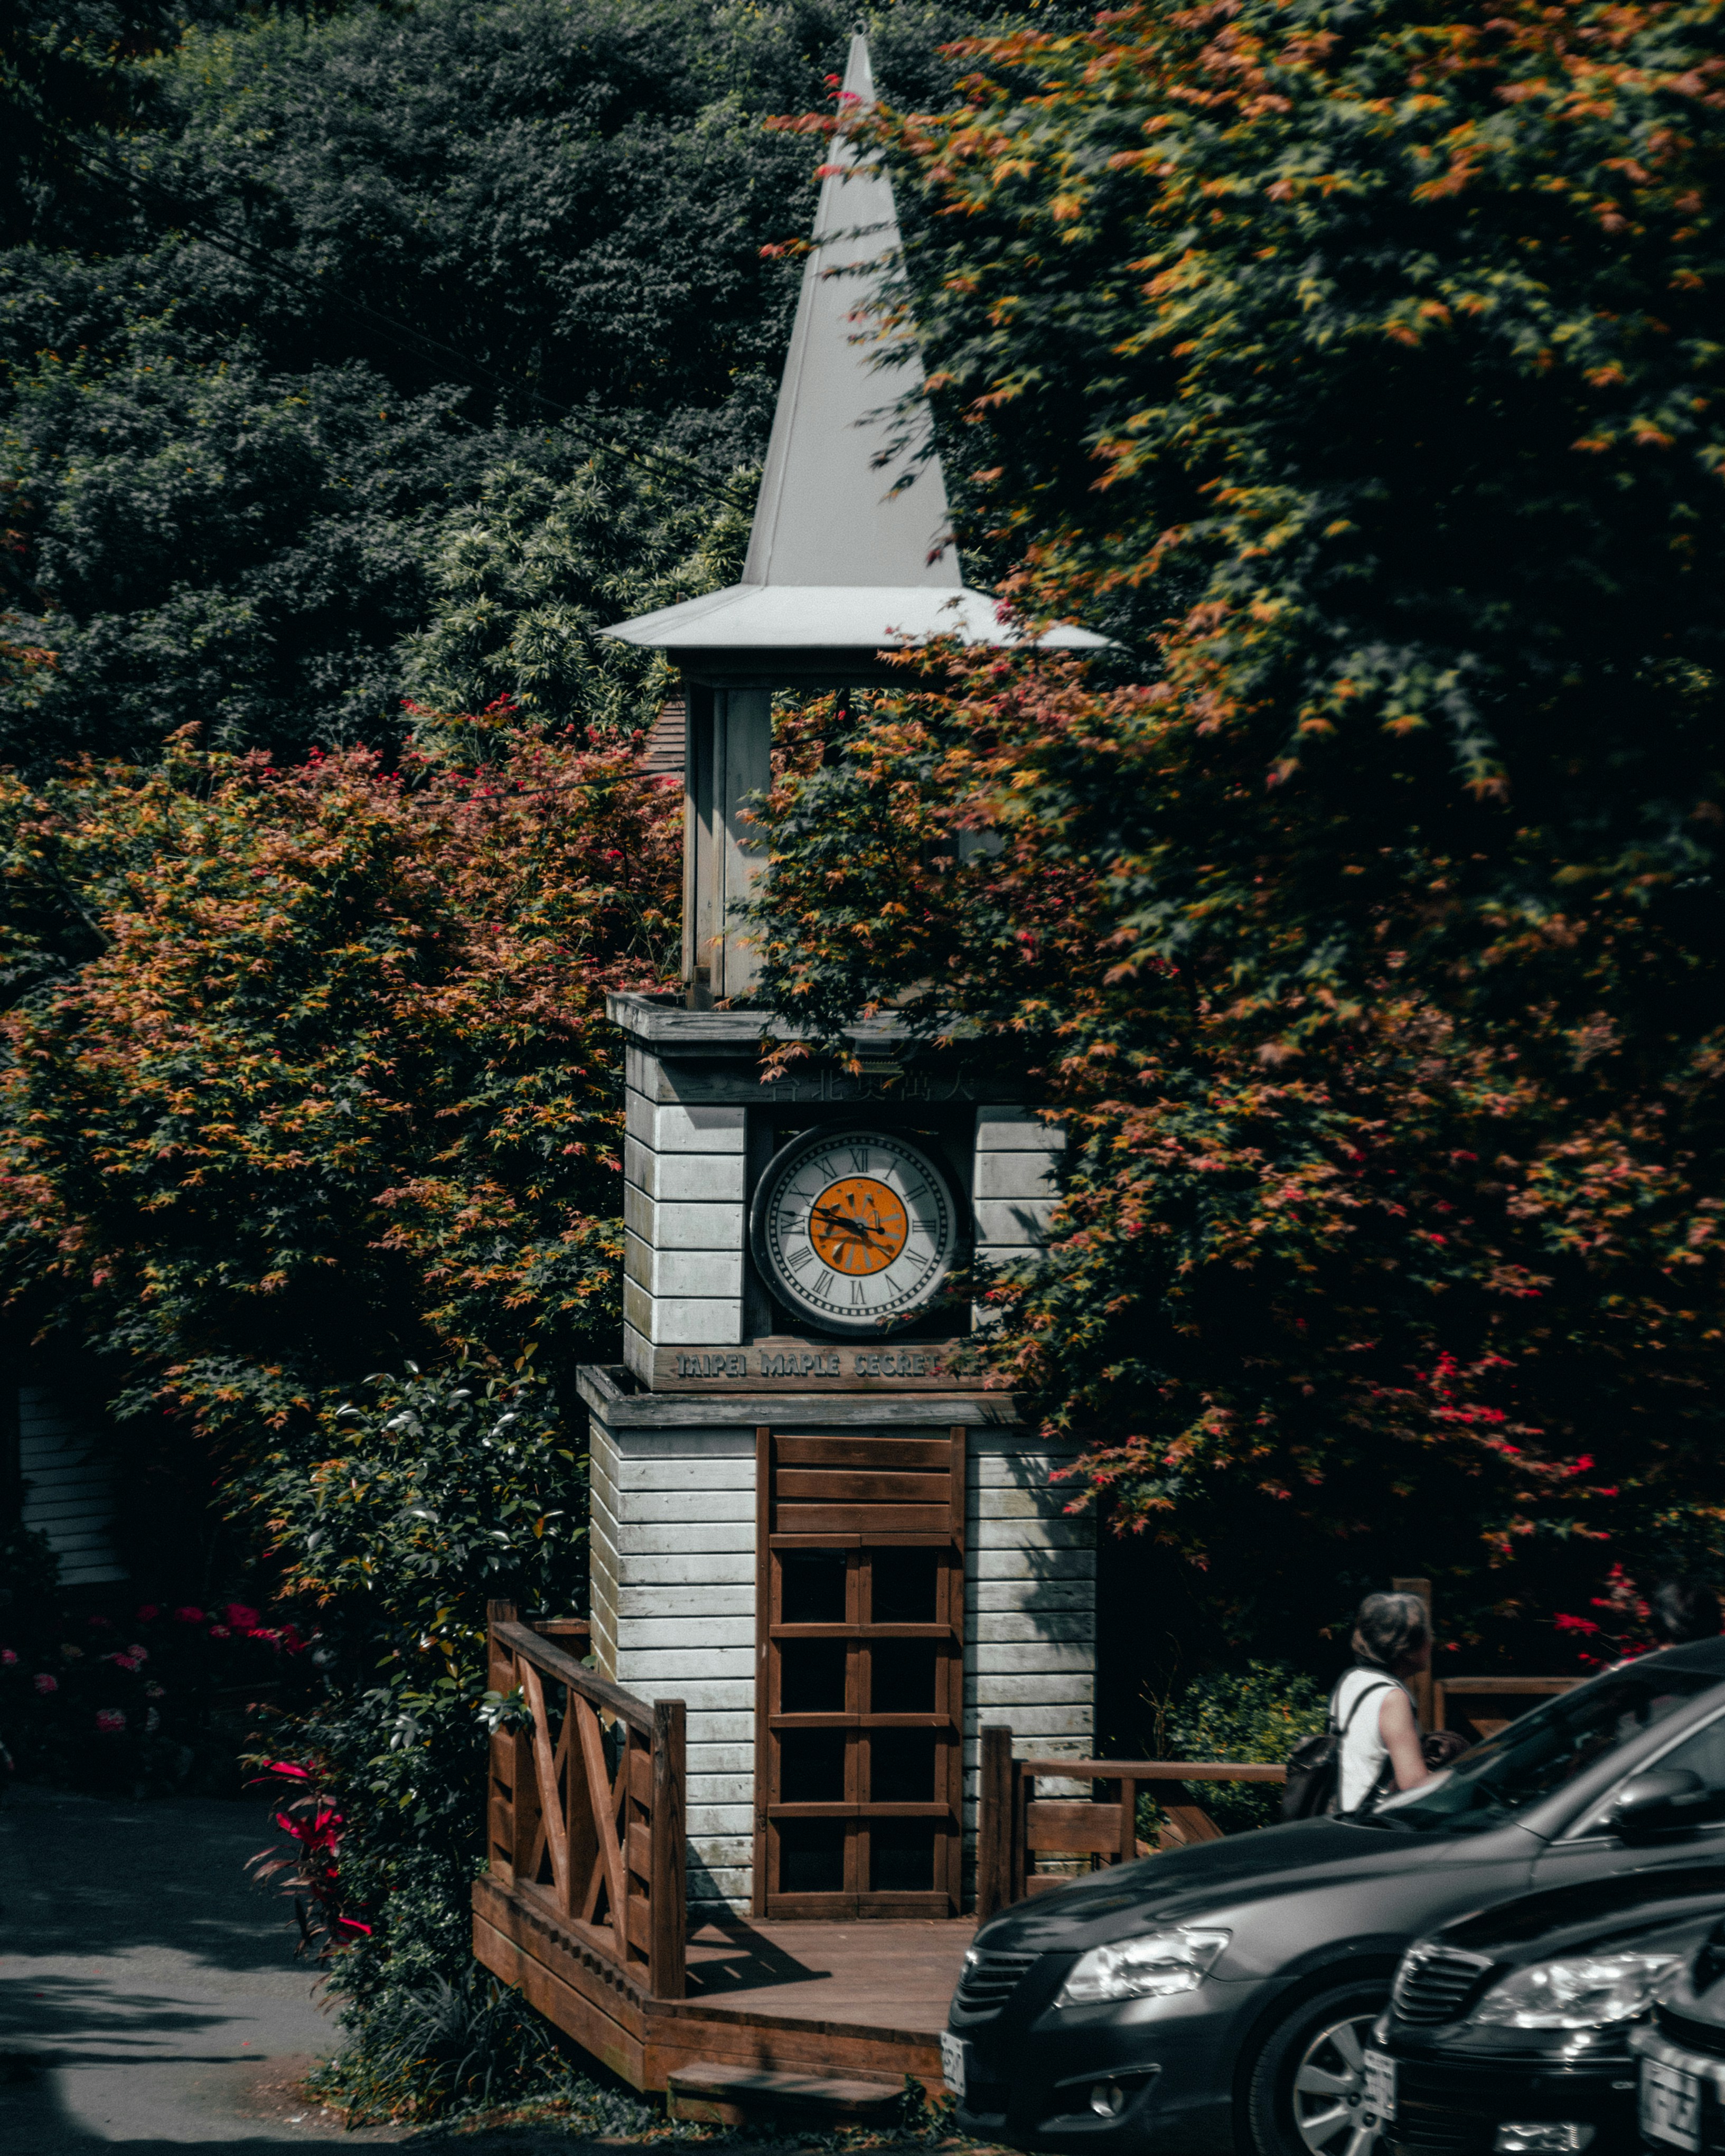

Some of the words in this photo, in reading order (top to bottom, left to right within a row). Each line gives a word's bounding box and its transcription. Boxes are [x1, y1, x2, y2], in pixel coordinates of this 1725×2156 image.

[812, 1156, 839, 1184] XI
[848, 1148, 870, 1173] XII
[883, 1158, 901, 1181] I
[788, 1183, 816, 1206] X
[902, 1183, 928, 1205] II
[781, 1217, 805, 1236] IX
[912, 1218, 936, 1235] III
[786, 1245, 814, 1273] VIII
[904, 1246, 929, 1271] IV
[811, 1269, 835, 1298] VII
[850, 1280, 867, 1305] VI
[885, 1273, 904, 1298] V
[676, 1354, 746, 1377] TAIPEI
[761, 1354, 840, 1377] MAPLE
[854, 1354, 940, 1377] SECRET
